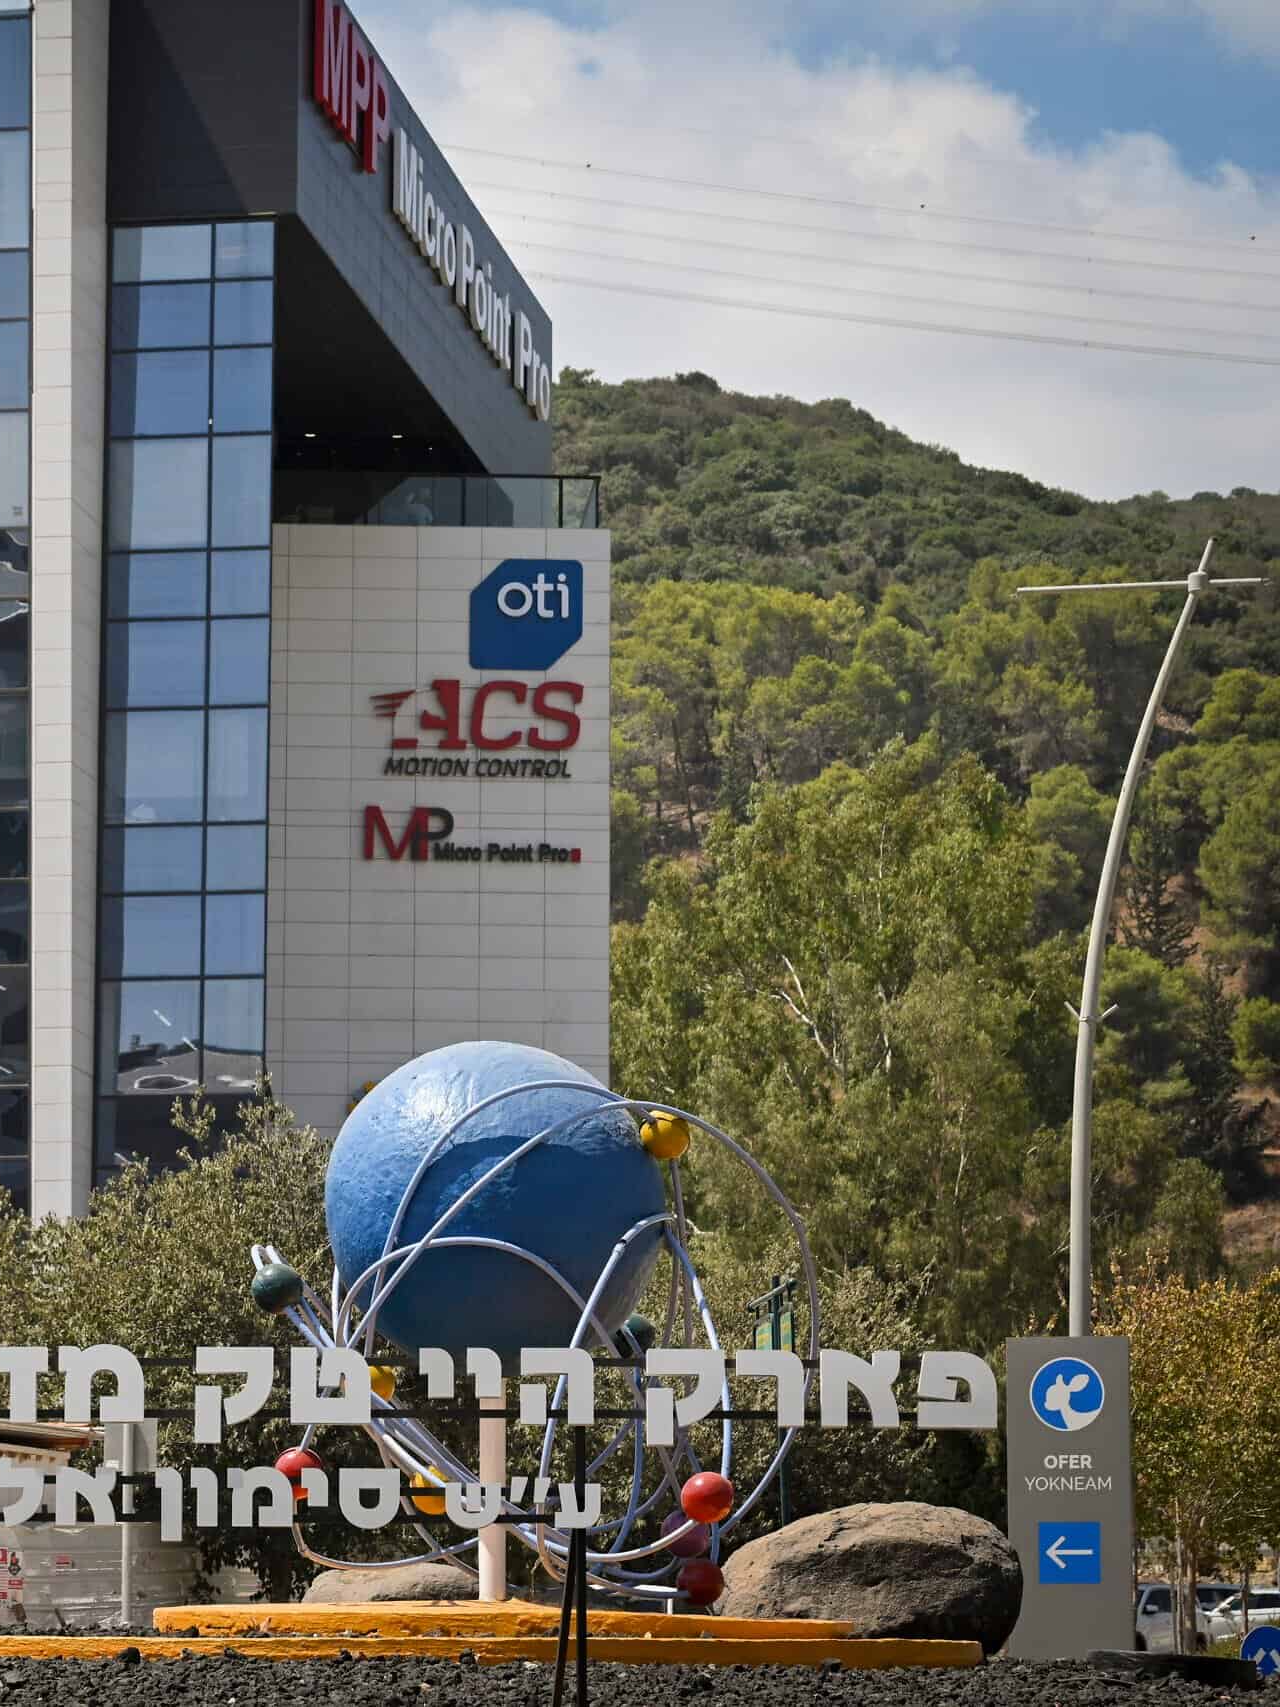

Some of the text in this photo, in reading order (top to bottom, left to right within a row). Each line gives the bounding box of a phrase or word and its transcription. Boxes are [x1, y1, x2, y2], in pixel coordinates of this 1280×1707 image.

[312, 0, 391, 174] MPP
[392, 127, 551, 422] Micro Point Pro
[497, 572, 570, 619] oti
[372, 679, 584, 750] ACS
[383, 757, 572, 779] MOTION CONTROL
[433, 843, 569, 863] Micro Point Pro
[195, 1346, 371, 1444] טק
[420, 1347, 594, 1425] היי
[646, 1348, 998, 1447] פארק
[1024, 1476, 1113, 1492] YOKNEAM
[1044, 1454, 1093, 1470] OFER
[155, 1467, 401, 1542] סימון
